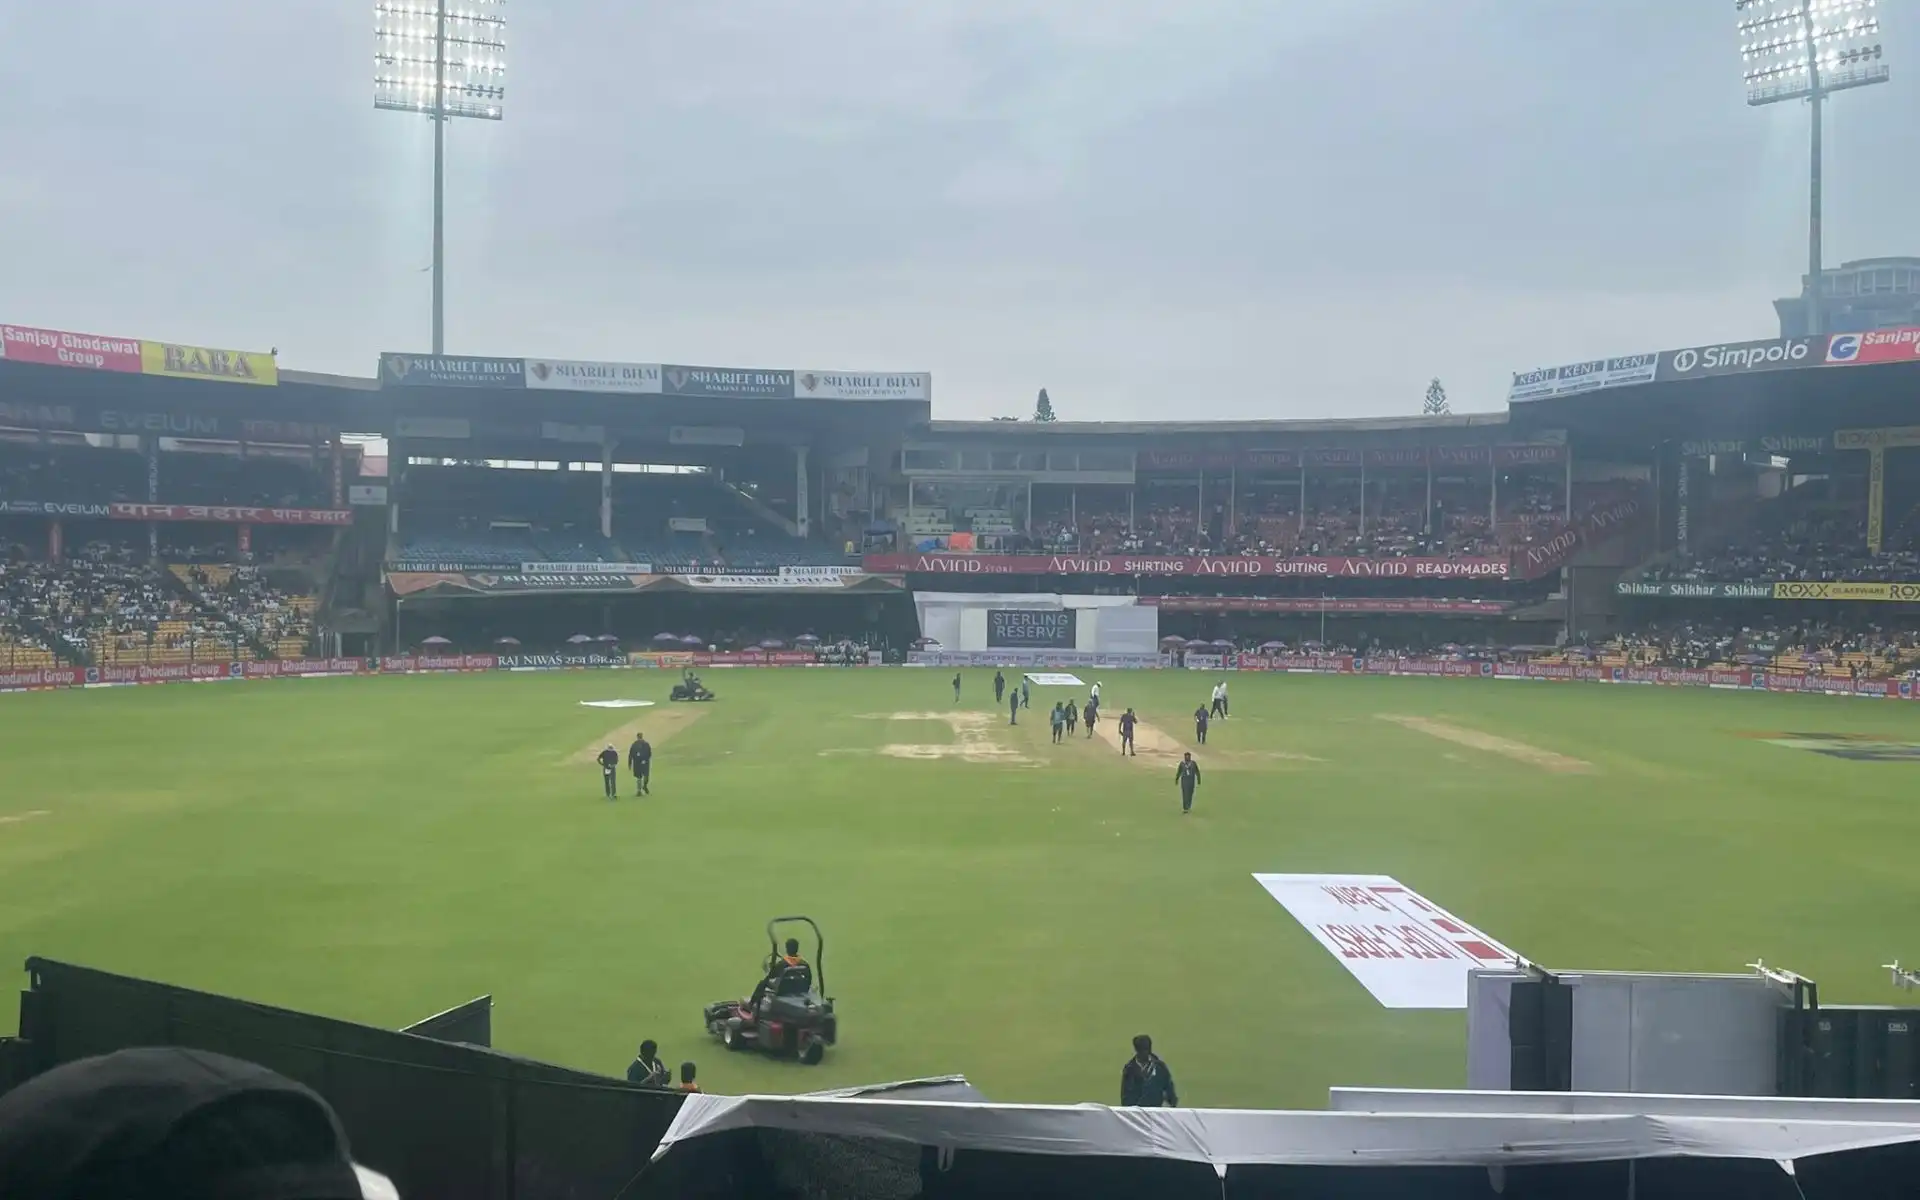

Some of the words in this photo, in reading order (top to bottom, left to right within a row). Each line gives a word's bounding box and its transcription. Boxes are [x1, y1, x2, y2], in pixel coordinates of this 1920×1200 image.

[4, 327, 57, 348] Sanjay
[61, 334, 140, 354] Ghodawat
[58, 348, 104, 368] Group
[1702, 339, 1808, 368] Simpolo
[484, 362, 520, 373] BHAI
[1614, 354, 1649, 369] KENT
[1565, 363, 1597, 377] KENT
[691, 371, 753, 384] SHARIEF
[755, 374, 790, 385] BHAI
[886, 376, 921, 387] BHAI
[1519, 370, 1551, 385] KENT
[1124, 561, 1184, 571] SHIRTING
[1275, 563, 1328, 573] SUITING
[1416, 563, 1507, 574] READYMADES
[1618, 582, 1662, 596] Shikhar
[1670, 583, 1716, 597] Shikhar
[1724, 584, 1771, 597] Shikhar
[1778, 584, 1829, 597] ROXX
[993, 612, 1069, 625] STERLING
[996, 625, 1066, 638] RESERVE
[498, 655, 519, 666] RAJ
[524, 654, 564, 666] NIWAS
[104, 665, 137, 684] Sanjay
[191, 662, 220, 679] Group
[247, 660, 278, 677] Sanjay
[331, 659, 359, 674] Group
[0, 671, 40, 685] odawat
[44, 669, 76, 685] Group
[1320, 886, 1391, 912] Bank
[1317, 924, 1404, 959] FIRST
[1375, 924, 1460, 959] IDFC
